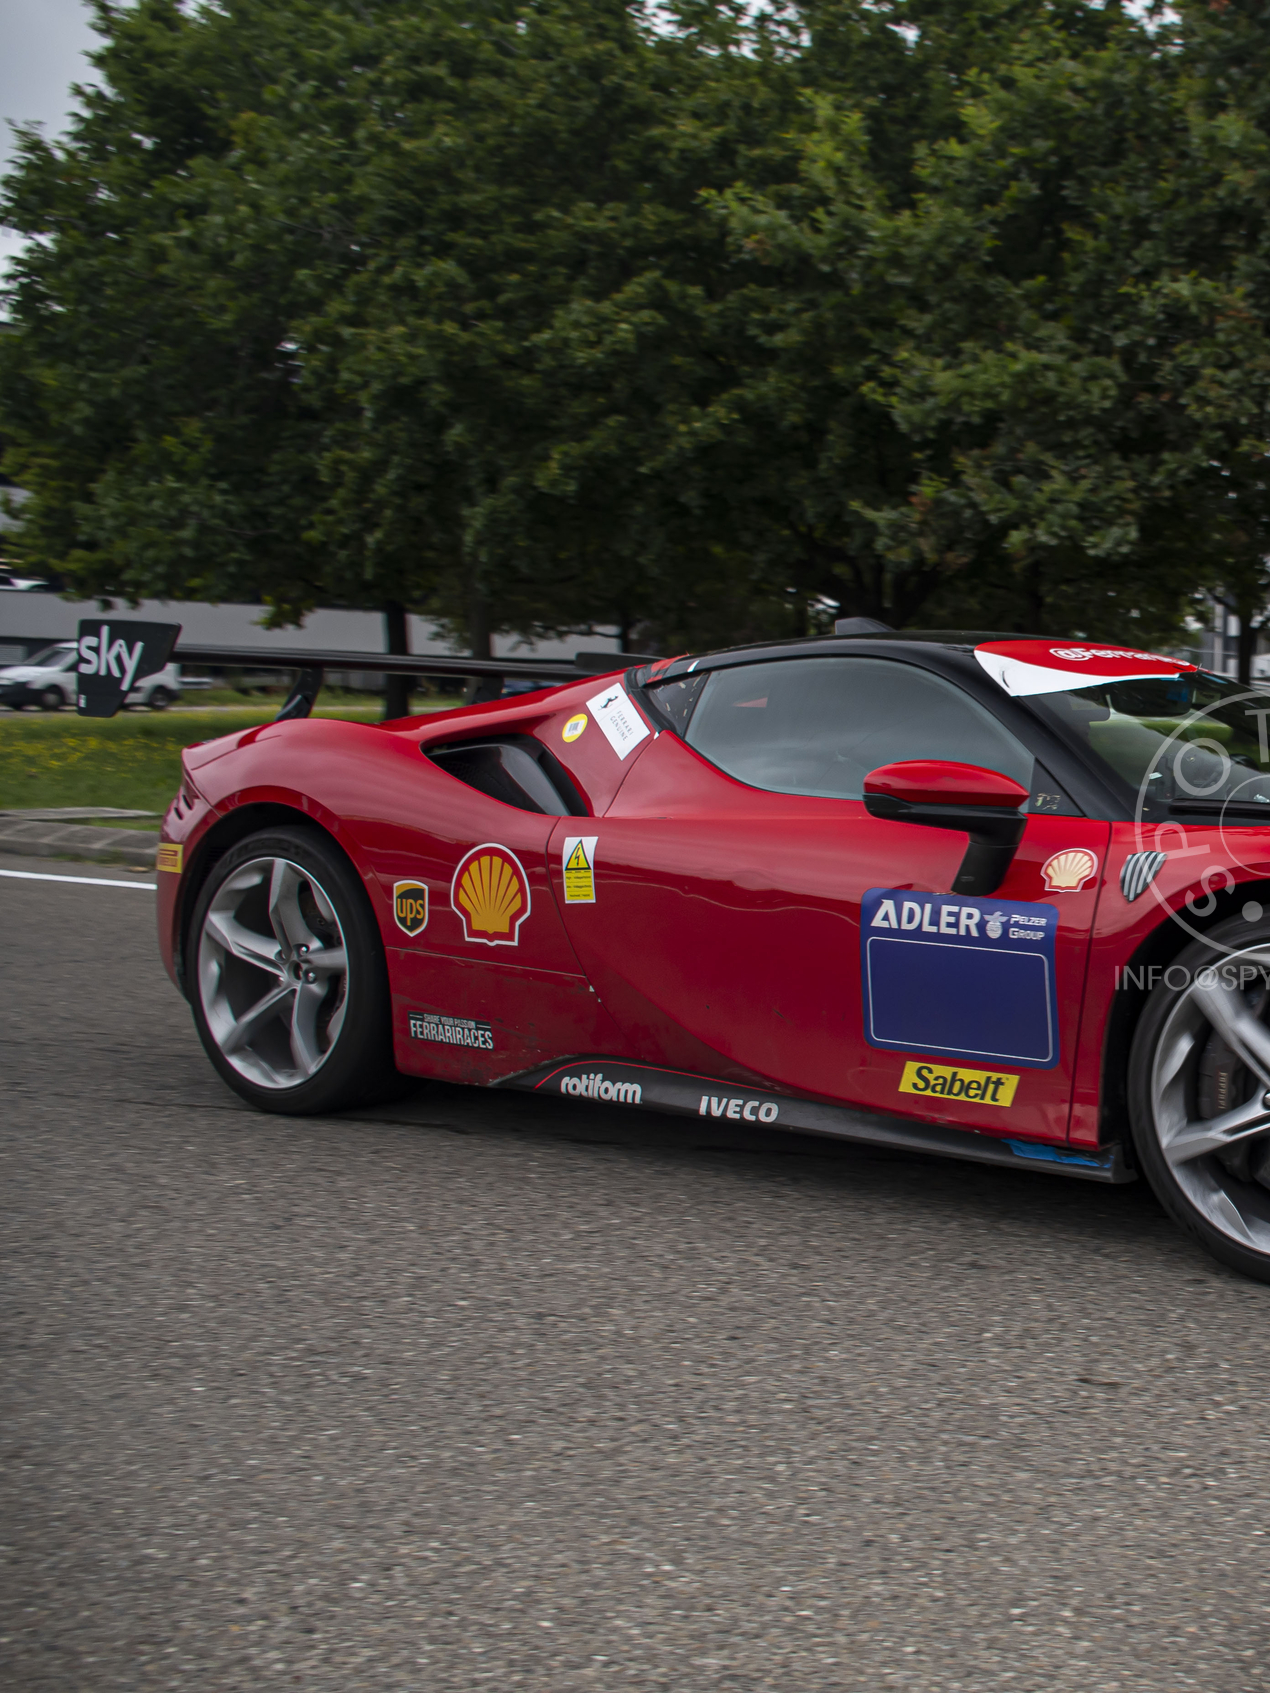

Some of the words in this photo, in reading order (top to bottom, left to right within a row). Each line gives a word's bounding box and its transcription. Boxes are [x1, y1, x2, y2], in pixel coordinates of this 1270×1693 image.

[78, 625, 145, 691] sky
[610, 715, 629, 742] GENUINE
[617, 710, 634, 736] FERRARI
[397, 898, 424, 926] ups
[870, 899, 980, 937] ADLER
[410, 1019, 494, 1049] FERRARIRACES
[560, 1073, 642, 1104] rotiform
[911, 1065, 1005, 1102] Sabelt
[699, 1095, 779, 1123] IVECO
